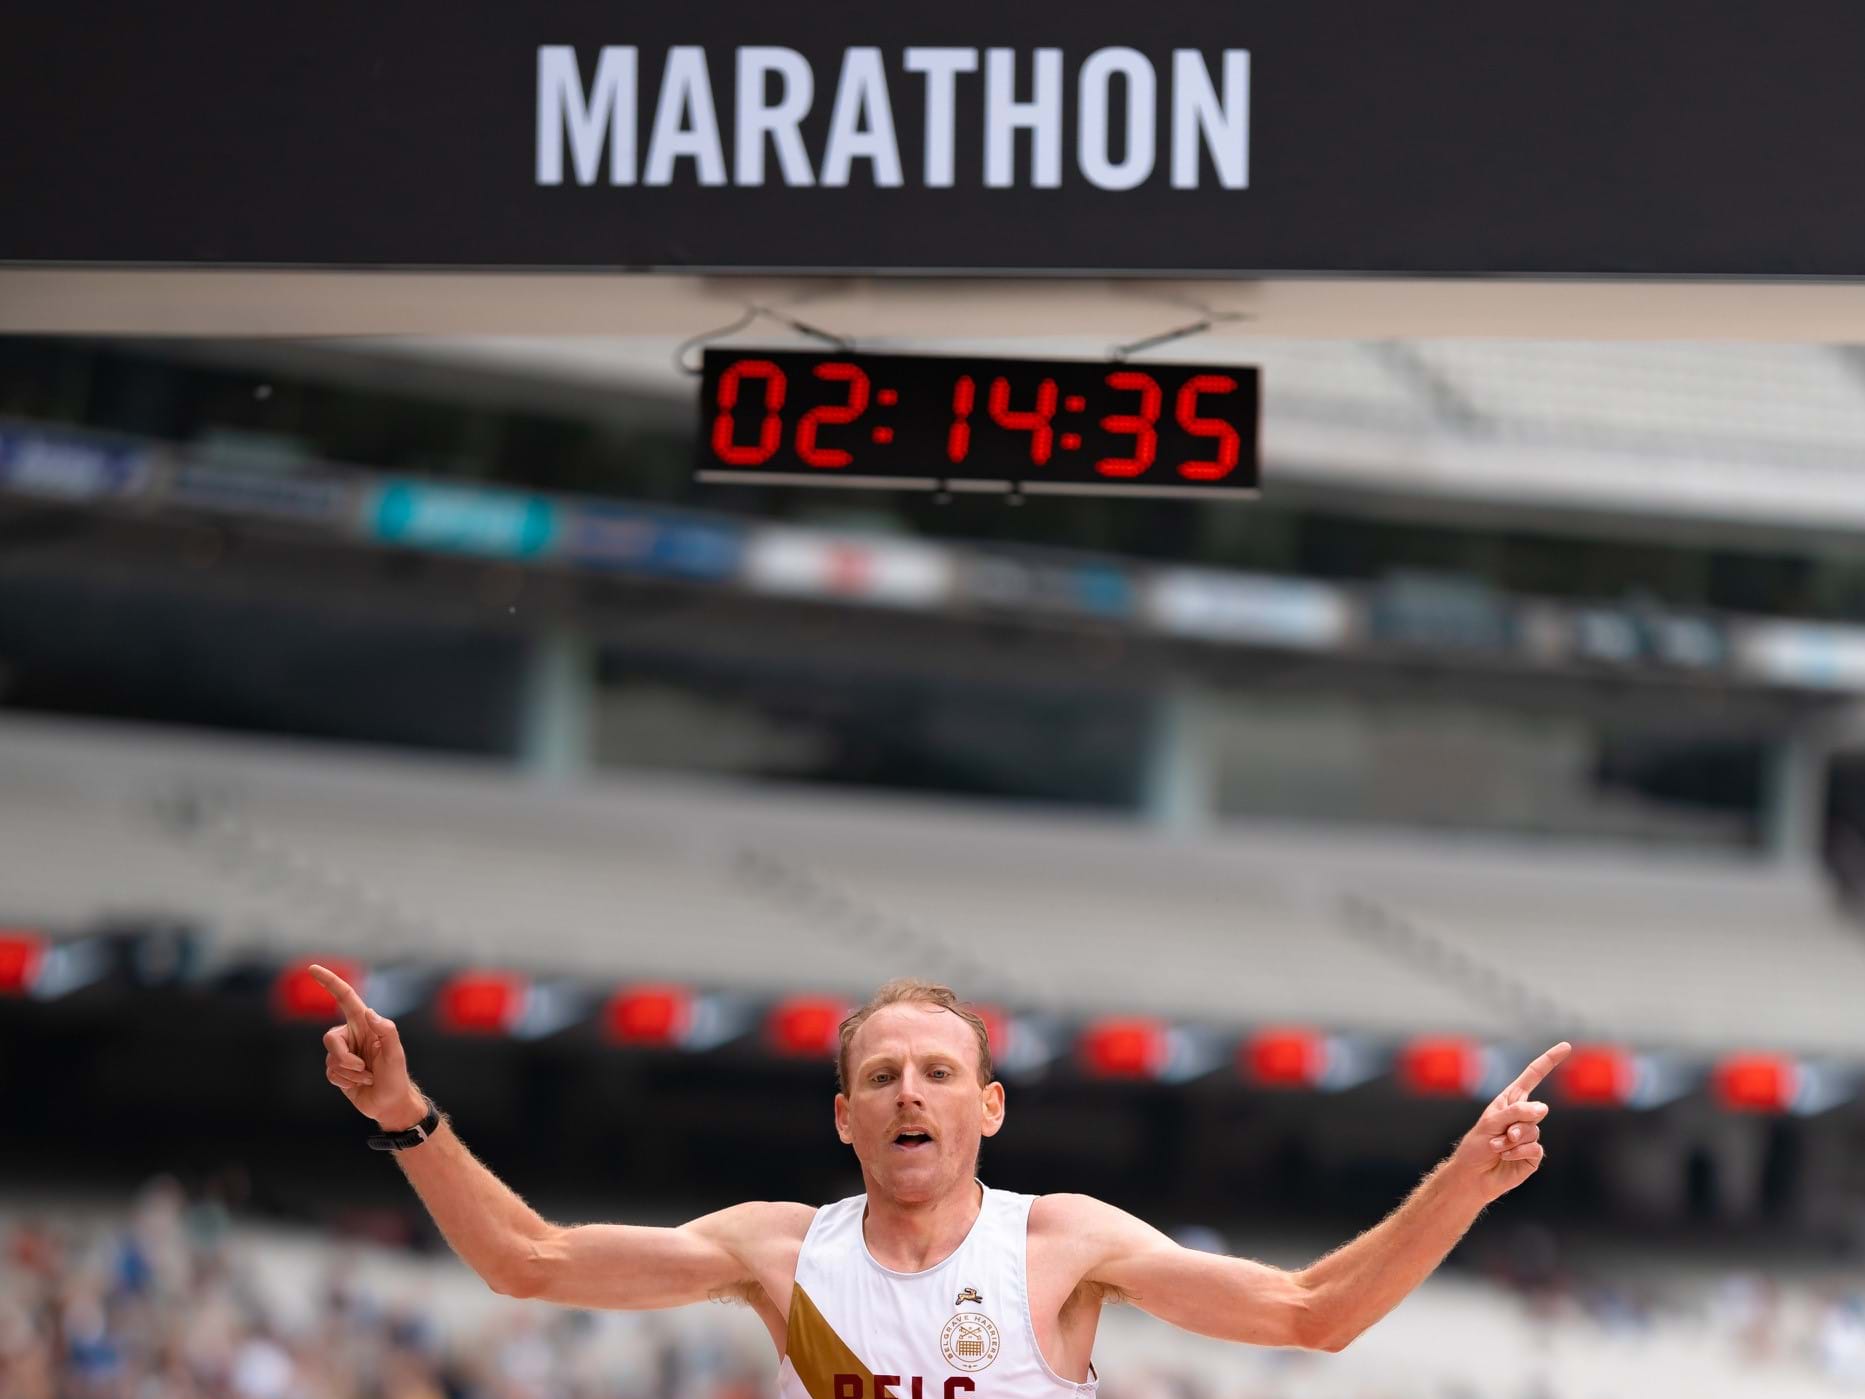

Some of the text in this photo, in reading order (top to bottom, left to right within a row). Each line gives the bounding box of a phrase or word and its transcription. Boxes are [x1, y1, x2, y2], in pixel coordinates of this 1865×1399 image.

[536, 45, 1252, 190] MARATHON
[714, 361, 1241, 481] 02:14:35
[943, 1315, 998, 1360] BELGRAVE HARRIERS
